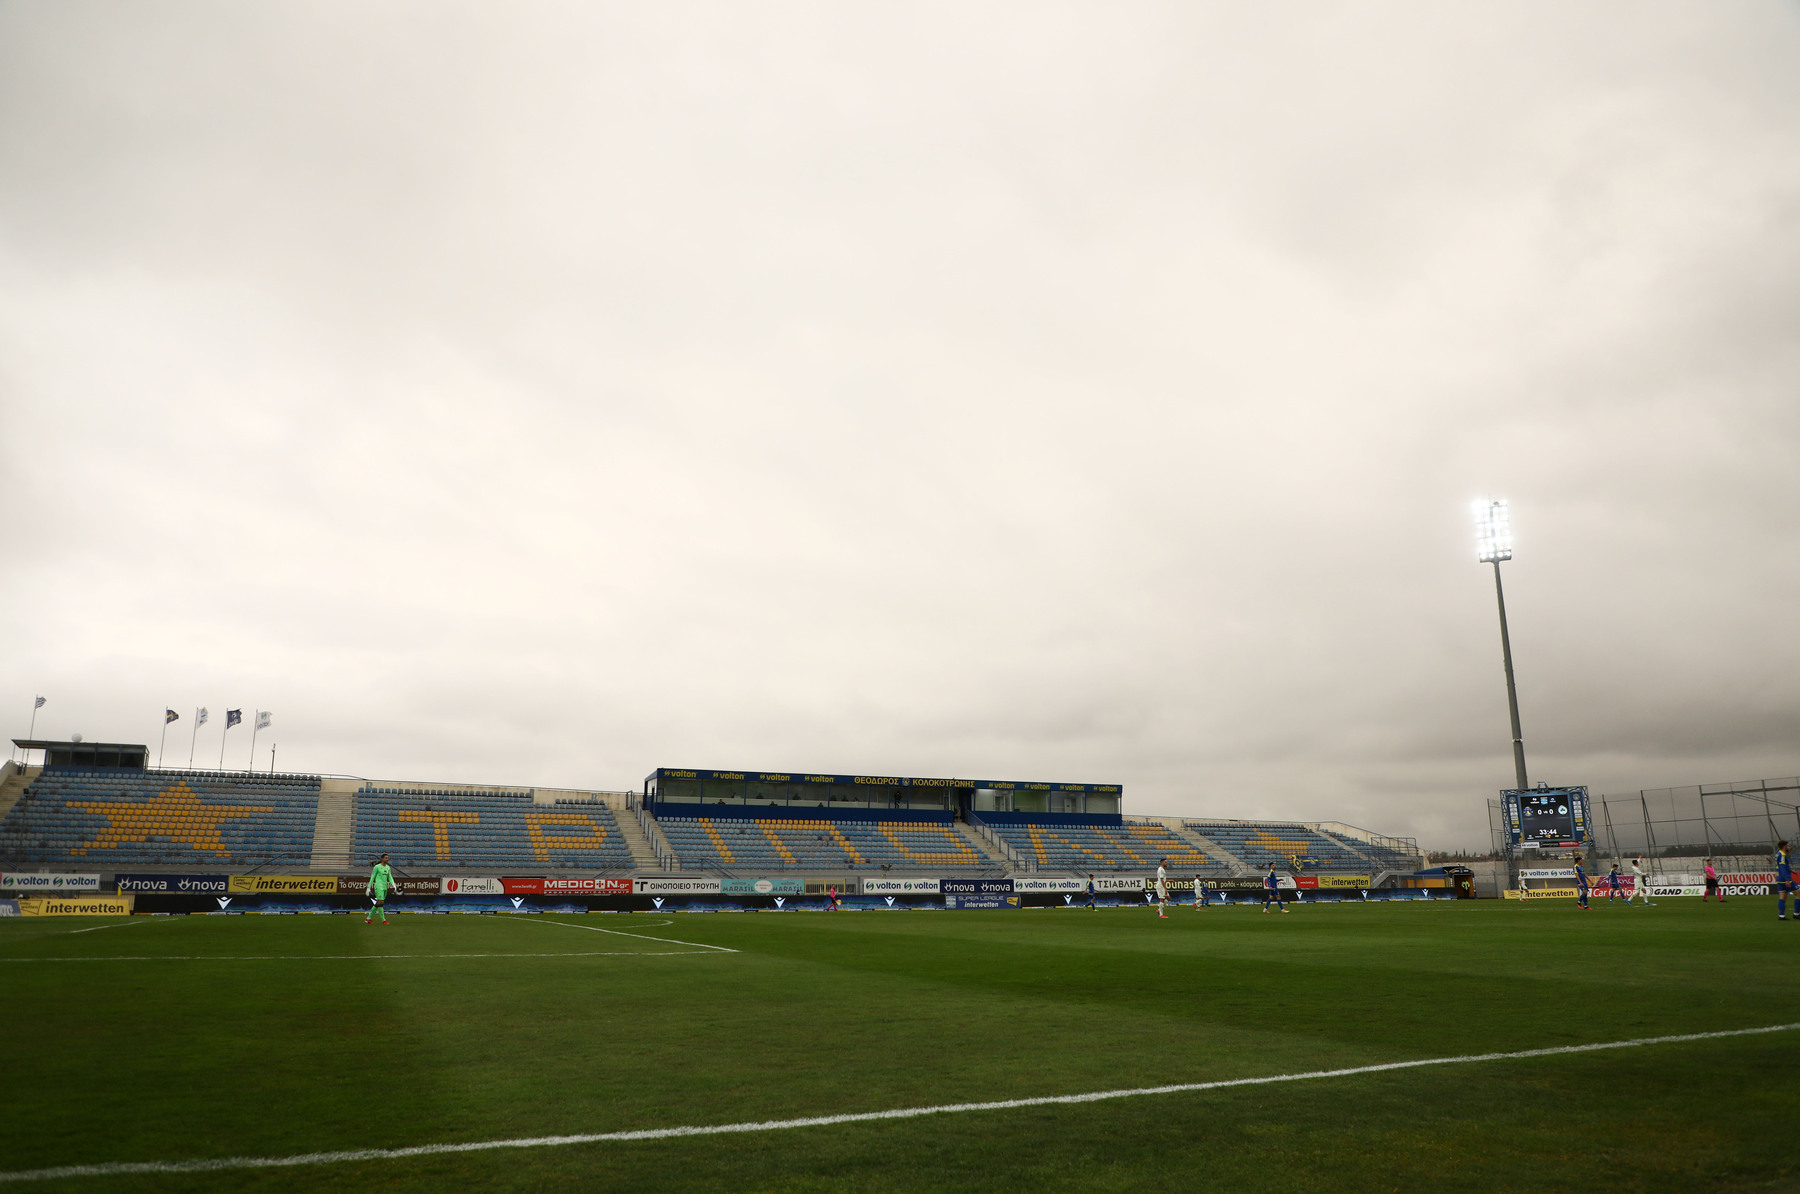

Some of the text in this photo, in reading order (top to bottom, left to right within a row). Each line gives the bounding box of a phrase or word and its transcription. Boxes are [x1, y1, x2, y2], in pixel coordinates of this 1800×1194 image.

[671, 770, 697, 778] volton
[720, 772, 745, 780] volton
[811, 775, 834, 783] volton
[854, 776, 975, 788] ΘΕΟΔΩΡΟΣ ΚΟΛΟΚΟΤΡΩΝΗΣ
[17, 876, 97, 886] volton volton
[132, 880, 226, 891] nova nova
[256, 877, 335, 889] interwetten
[1024, 881, 1080, 889] volton volton
[1097, 880, 1142, 889] ΤΣΙΑΒΛΗΣ
[1331, 877, 1369, 886] interwetten
[650, 882, 691, 890] ΟΙΝΟΠΟΙΕΙΟ
[876, 882, 939, 890] volton volton
[953, 884, 1011, 892] nova nova
[1527, 888, 1574, 898] nterwetten
[1593, 888, 1608, 897] Car
[45, 901, 124, 913] interwetten
